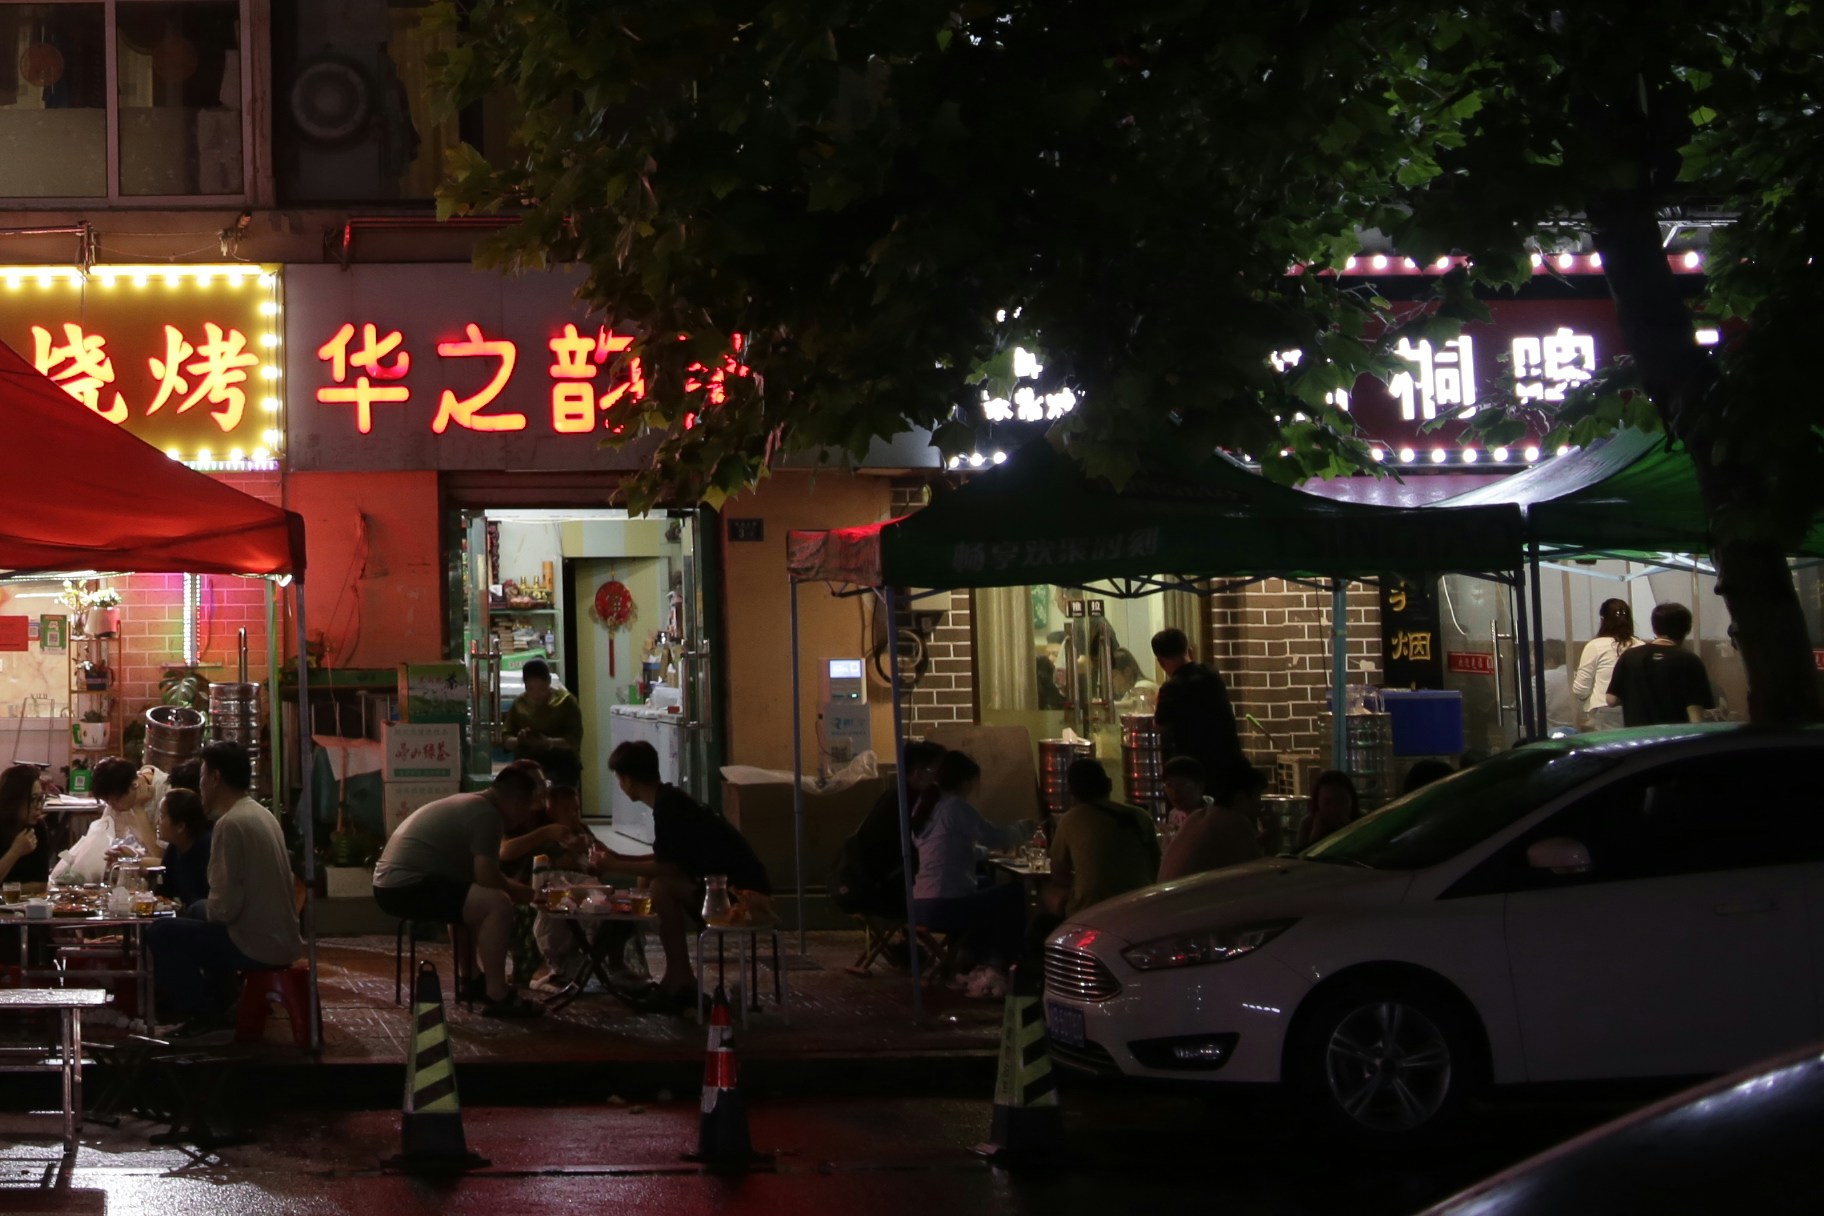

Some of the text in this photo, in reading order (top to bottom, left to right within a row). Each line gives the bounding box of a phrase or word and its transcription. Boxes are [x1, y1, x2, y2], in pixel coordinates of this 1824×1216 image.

[30, 322, 260, 433] 烧烤
[315, 322, 750, 435] 华之韵
